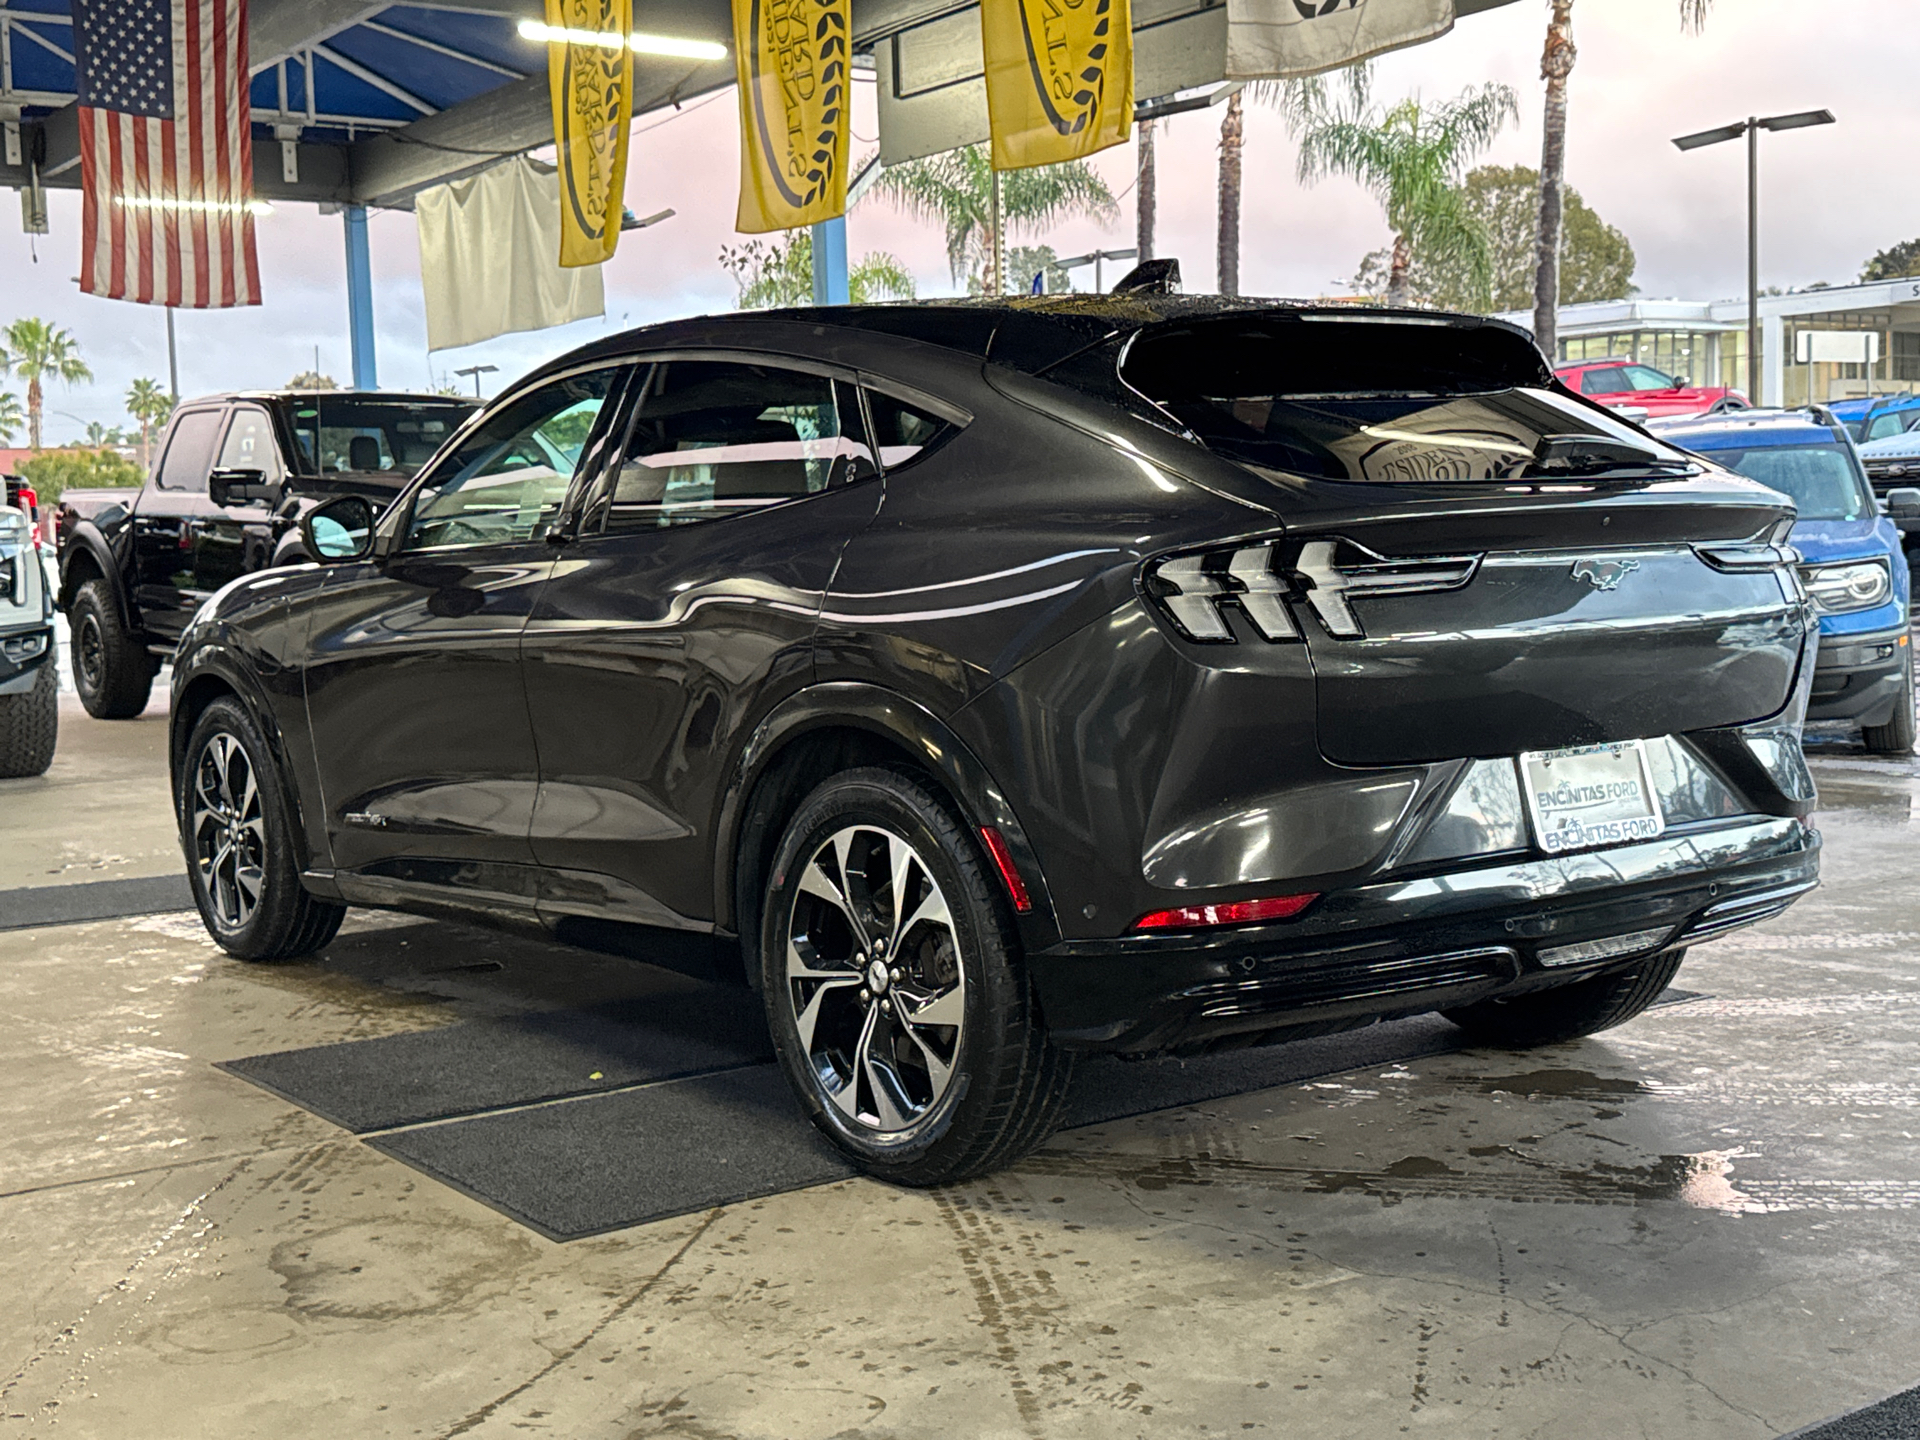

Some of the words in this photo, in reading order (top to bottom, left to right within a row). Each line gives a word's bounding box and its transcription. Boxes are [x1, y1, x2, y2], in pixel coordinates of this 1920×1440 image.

[1537, 783, 1606, 808] ENCINITAS
[1606, 780, 1639, 798] FORD
[1545, 822, 1621, 849] ENCINITAS
[1621, 818, 1658, 838] FORD
